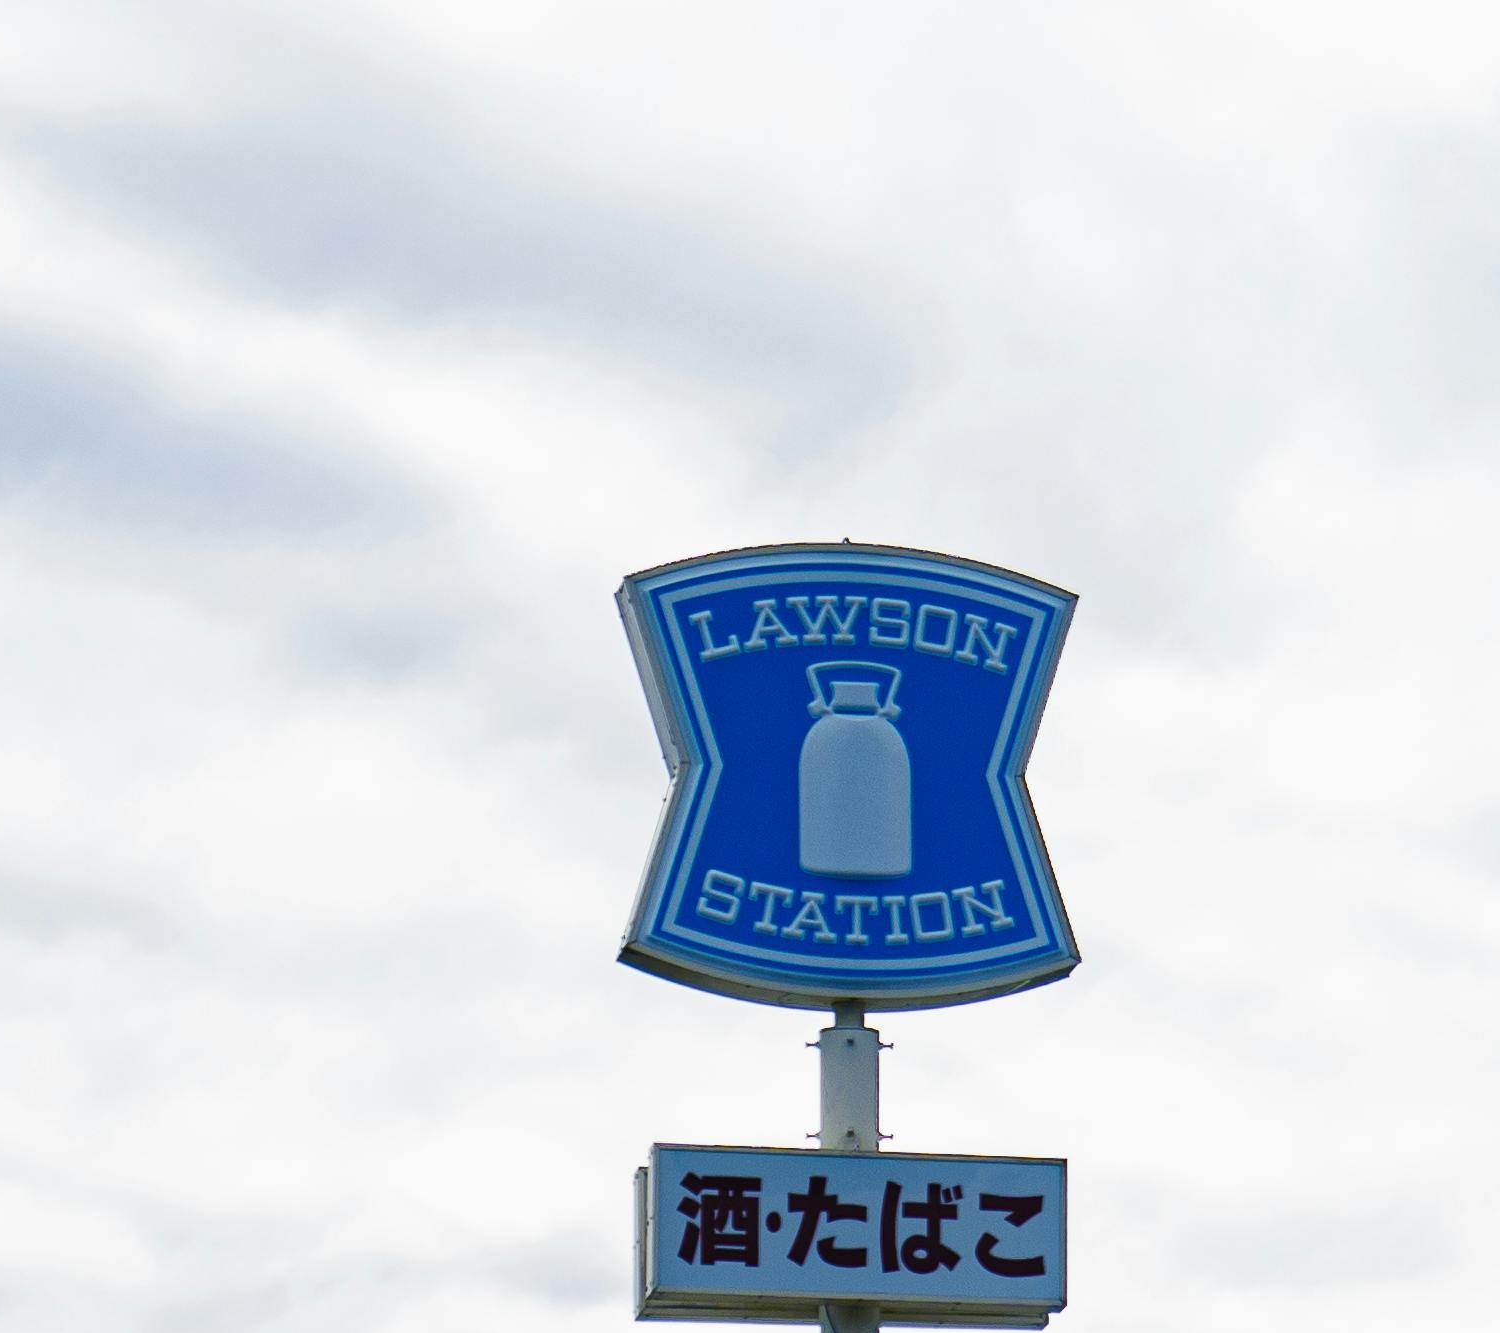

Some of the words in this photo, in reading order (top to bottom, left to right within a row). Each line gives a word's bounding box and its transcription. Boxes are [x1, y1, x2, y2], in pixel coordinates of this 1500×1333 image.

[688, 595, 1018, 675] LAWSON
[696, 868, 1015, 946] STATION
[677, 1171, 1046, 1277] 酒・たばこ
